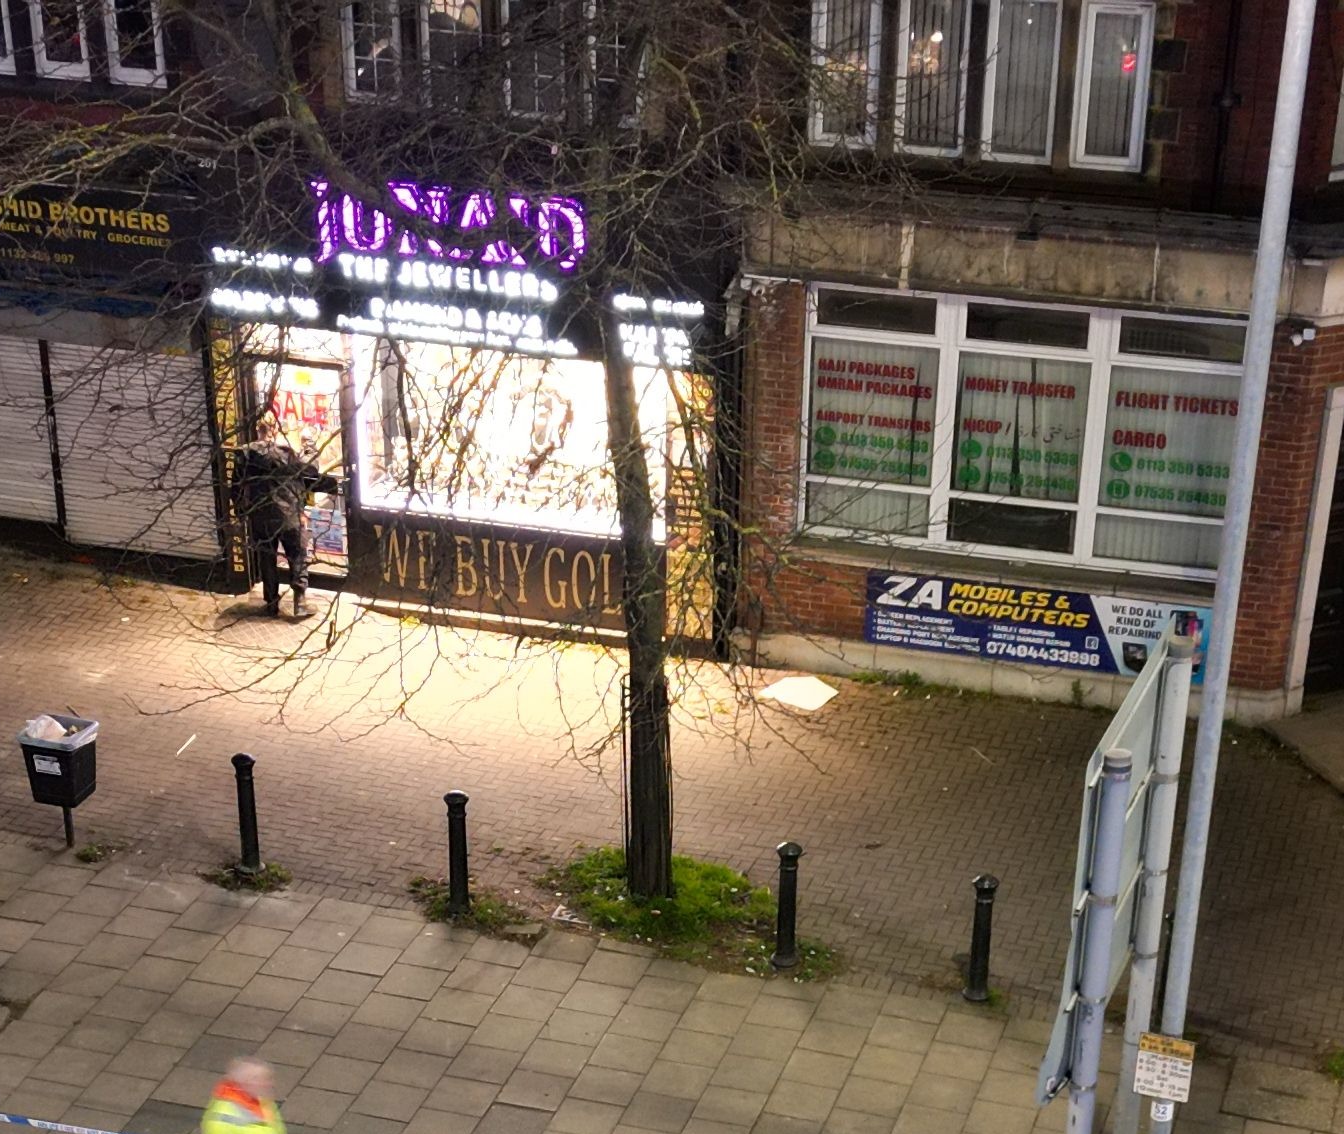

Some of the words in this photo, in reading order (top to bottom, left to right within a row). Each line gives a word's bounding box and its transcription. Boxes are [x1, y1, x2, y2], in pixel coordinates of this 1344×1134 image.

[49, 203, 170, 233] BROTHERS
[338, 253, 389, 281] THE
[818, 358, 846, 372] HAJJ
[848, 361, 915, 380] PACKAGES
[817, 376, 863, 392] UMRAH
[866, 381, 932, 399] PACKAGES
[965, 376, 1009, 393] MONEY
[1012, 381, 1076, 399] TRANSFER
[273, 390, 329, 426] SALE
[1115, 391, 1169, 410] FLIGHT
[1173, 395, 1238, 416] TICKETS
[816, 409, 865, 425] AIRPORT
[868, 415, 931, 433] TRANSFERS
[963, 418, 1002, 434] NICOP
[1113, 429, 1166, 450] CARGO
[1197, 463, 1230, 479] 5333
[454, 535, 533, 604] BUY
[544, 547, 623, 615] GOL
[876, 576, 943, 610] ZA
[949, 582, 1051, 607] MOBILES
[1055, 596, 1070, 609] &
[948, 599, 1090, 628] COMPUTERS
[1112, 605, 1128, 615] WE
[1129, 607, 1143, 616] DO
[1146, 609, 1163, 619] ALL
[1116, 616, 1141, 628] KIND
[1143, 619, 1156, 629] OF
